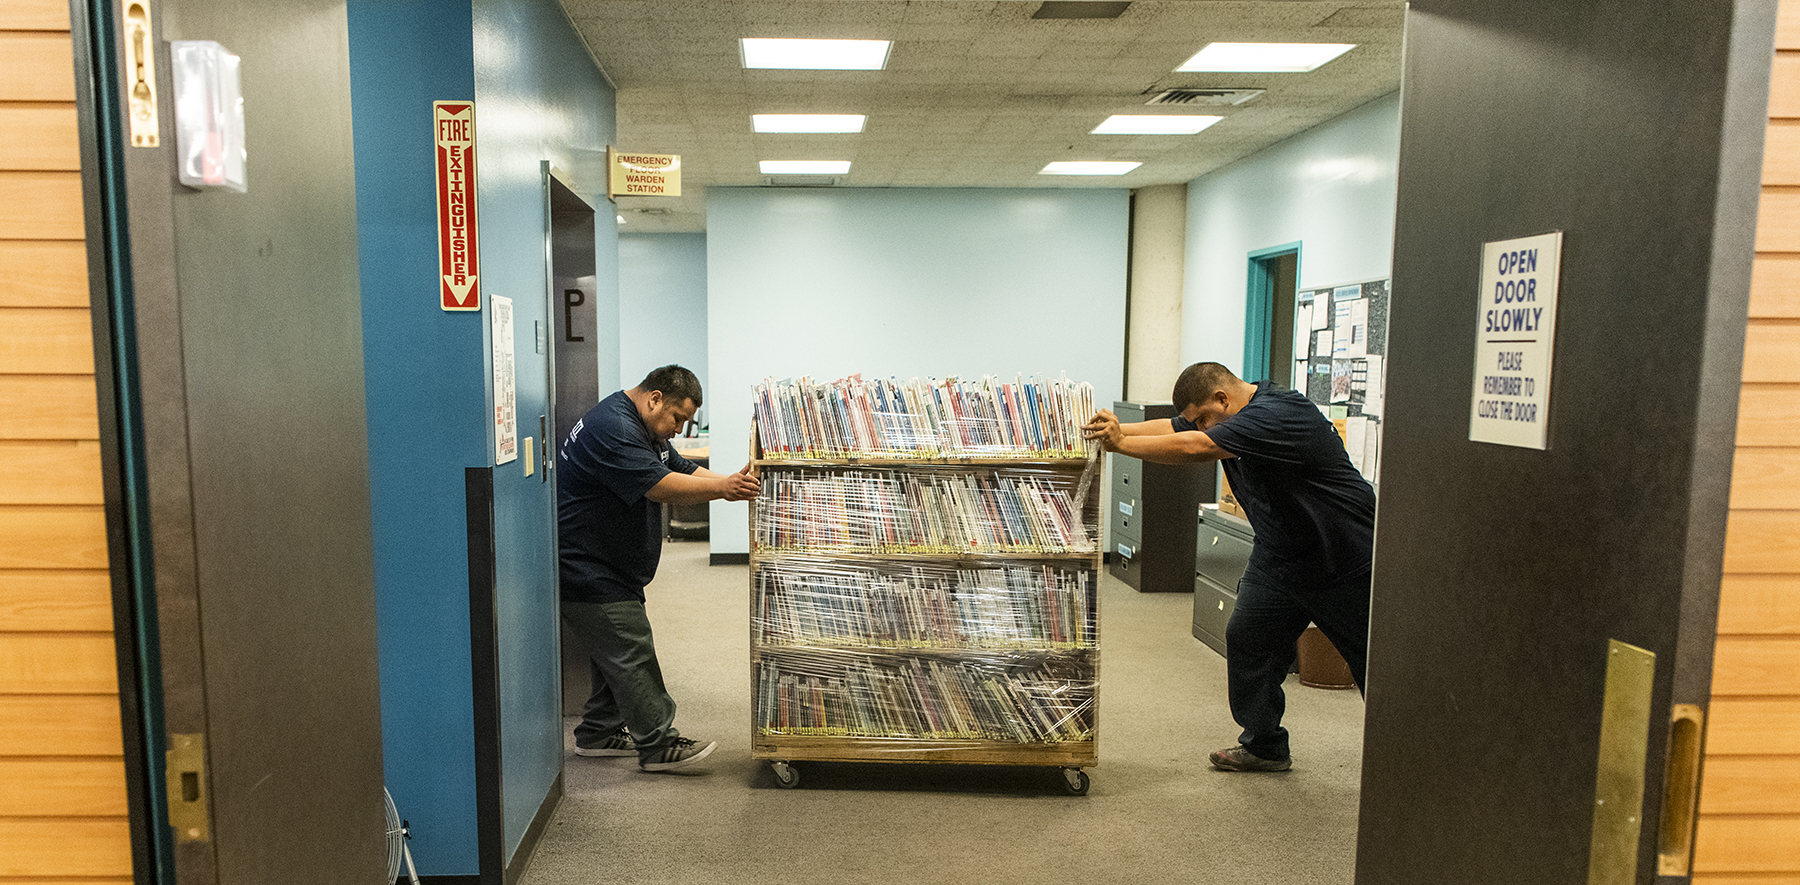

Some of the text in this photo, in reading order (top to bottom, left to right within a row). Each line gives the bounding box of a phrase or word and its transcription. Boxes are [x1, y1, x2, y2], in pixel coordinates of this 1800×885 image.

[439, 119, 470, 142] FIRE
[617, 155, 673, 165] EMERGENCY
[630, 165, 661, 174] FLOOR
[626, 175, 665, 184] WARDEN
[627, 184, 664, 193] STATION
[450, 145, 466, 286] EXTINGUISHER
[1498, 248, 1538, 276] OPEN
[1495, 278, 1536, 304] DOOR
[1485, 307, 1543, 333] SLOWLY
[1497, 352, 1522, 371] PLEASE
[1483, 376, 1535, 397] REMEMBER TO
[1478, 400, 1537, 423] CLOSE THE DOOR
